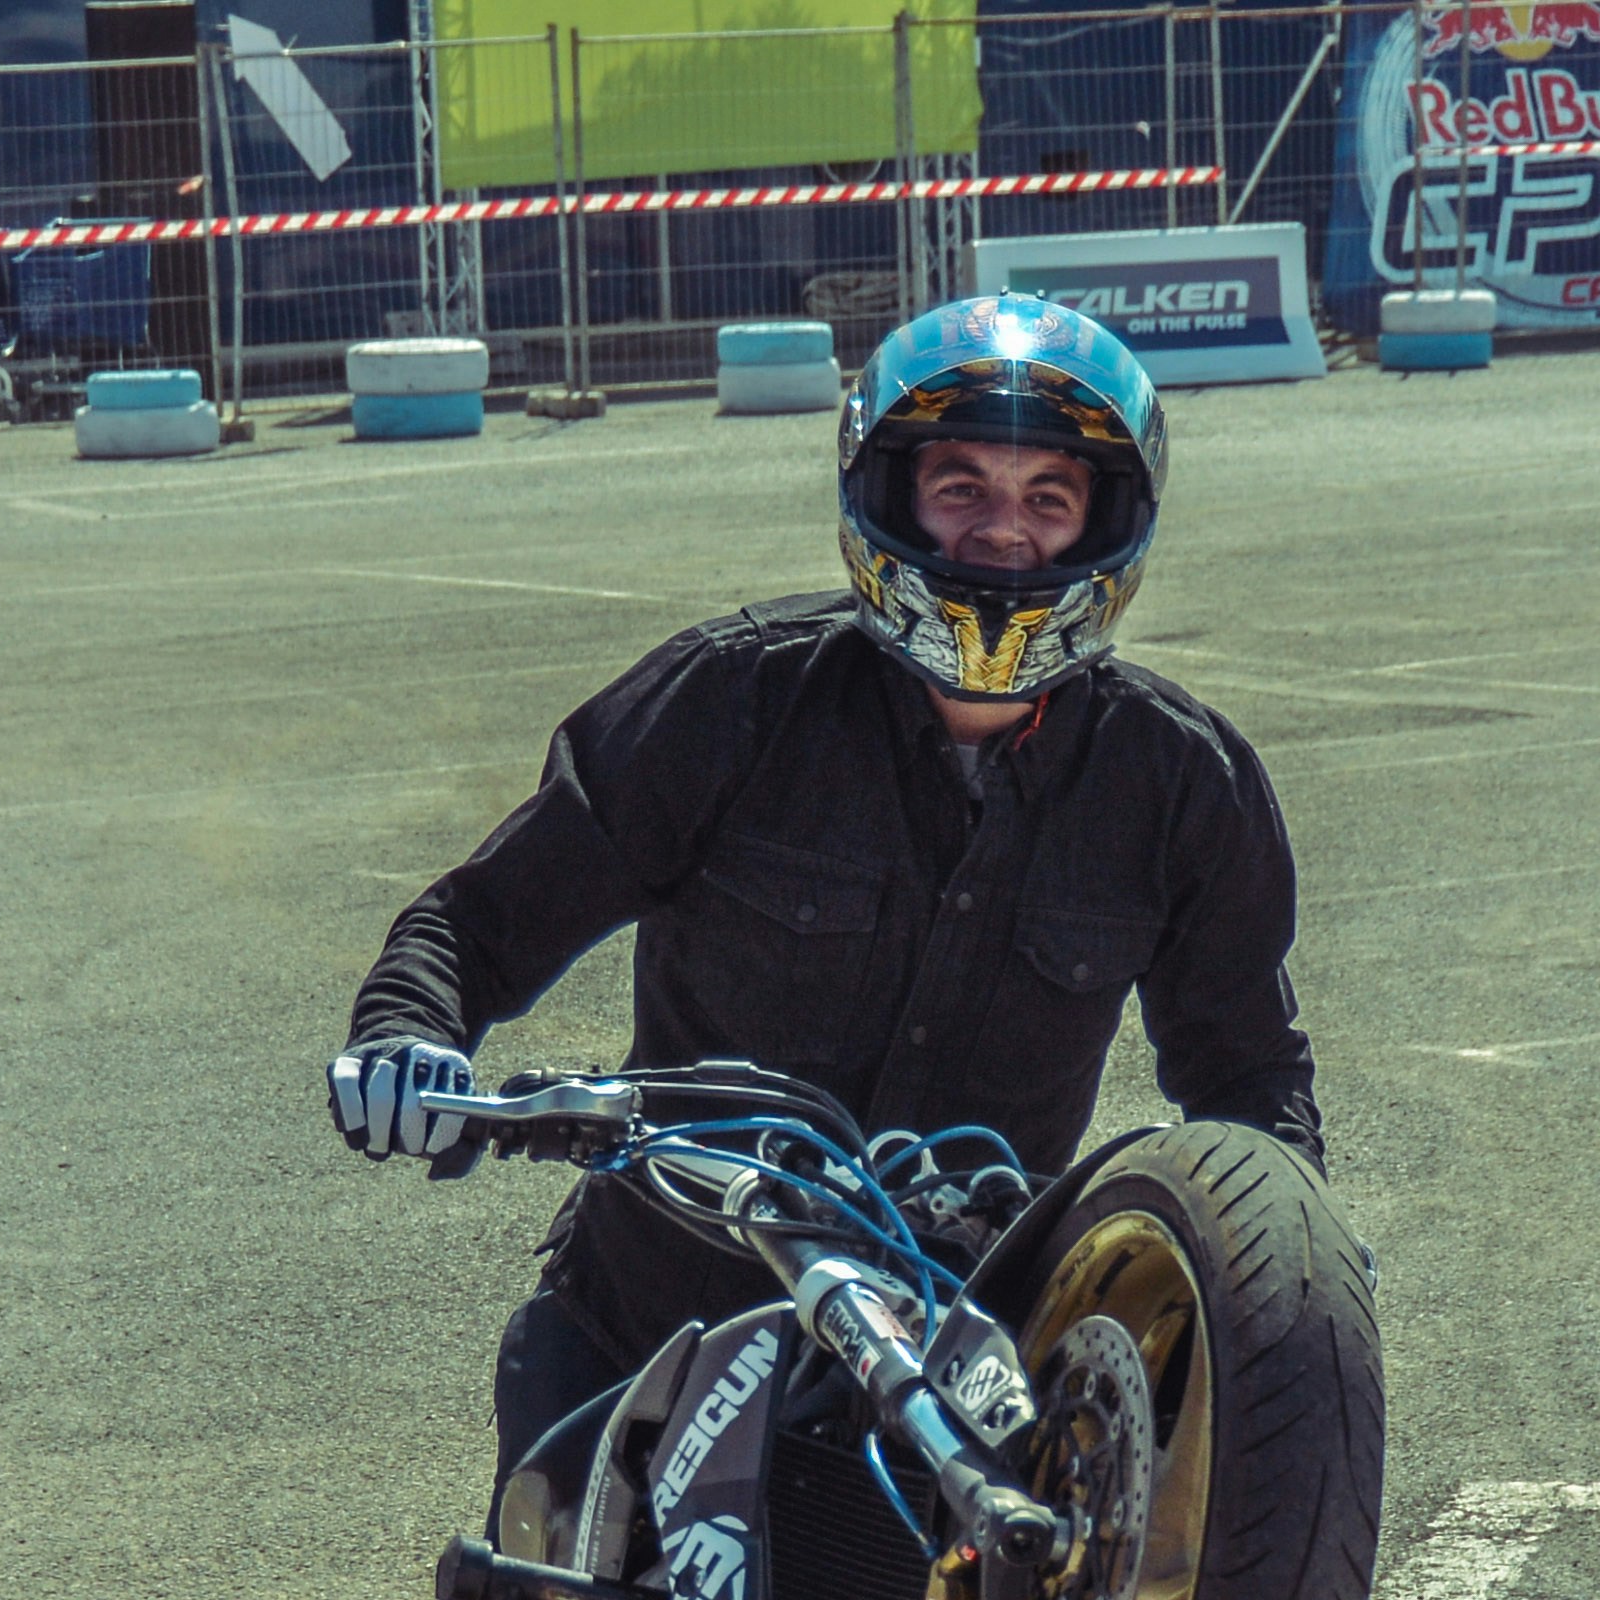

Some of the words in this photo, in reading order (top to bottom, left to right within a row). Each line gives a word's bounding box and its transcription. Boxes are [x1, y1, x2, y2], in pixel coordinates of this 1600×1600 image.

[1406, 68, 1538, 146] Red
[1050, 279, 1250, 317] FALKEN
[1127, 318, 1156, 334] ON
[1159, 316, 1191, 333] THE
[1194, 313, 1248, 331] PULSE
